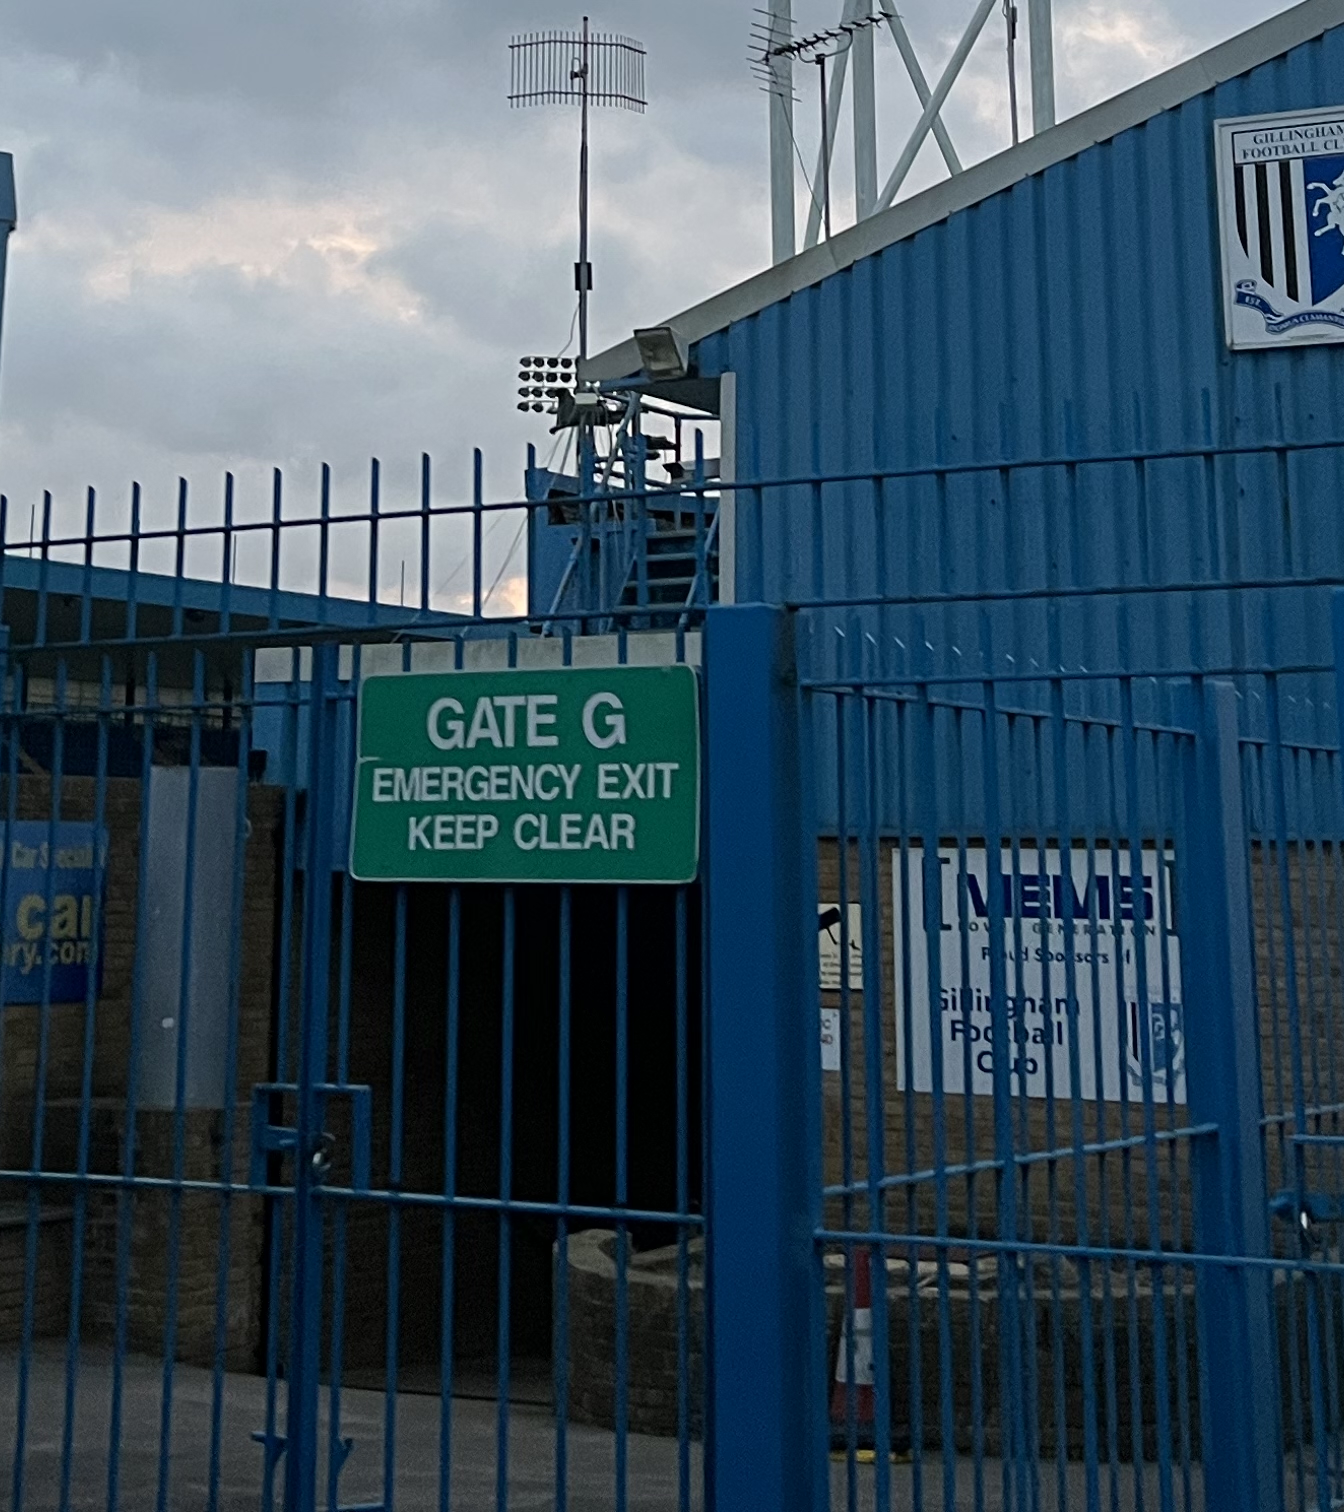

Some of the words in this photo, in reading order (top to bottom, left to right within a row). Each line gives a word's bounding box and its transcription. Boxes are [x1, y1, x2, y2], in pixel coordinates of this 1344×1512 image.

[1242, 141, 1318, 160] FOOTBALL
[426, 694, 559, 750] GATE
[582, 691, 627, 749] G
[372, 763, 582, 802] EMERGENCY
[597, 762, 680, 800] EXIT
[408, 814, 499, 851] KEEP
[513, 813, 636, 851] CLEAR
